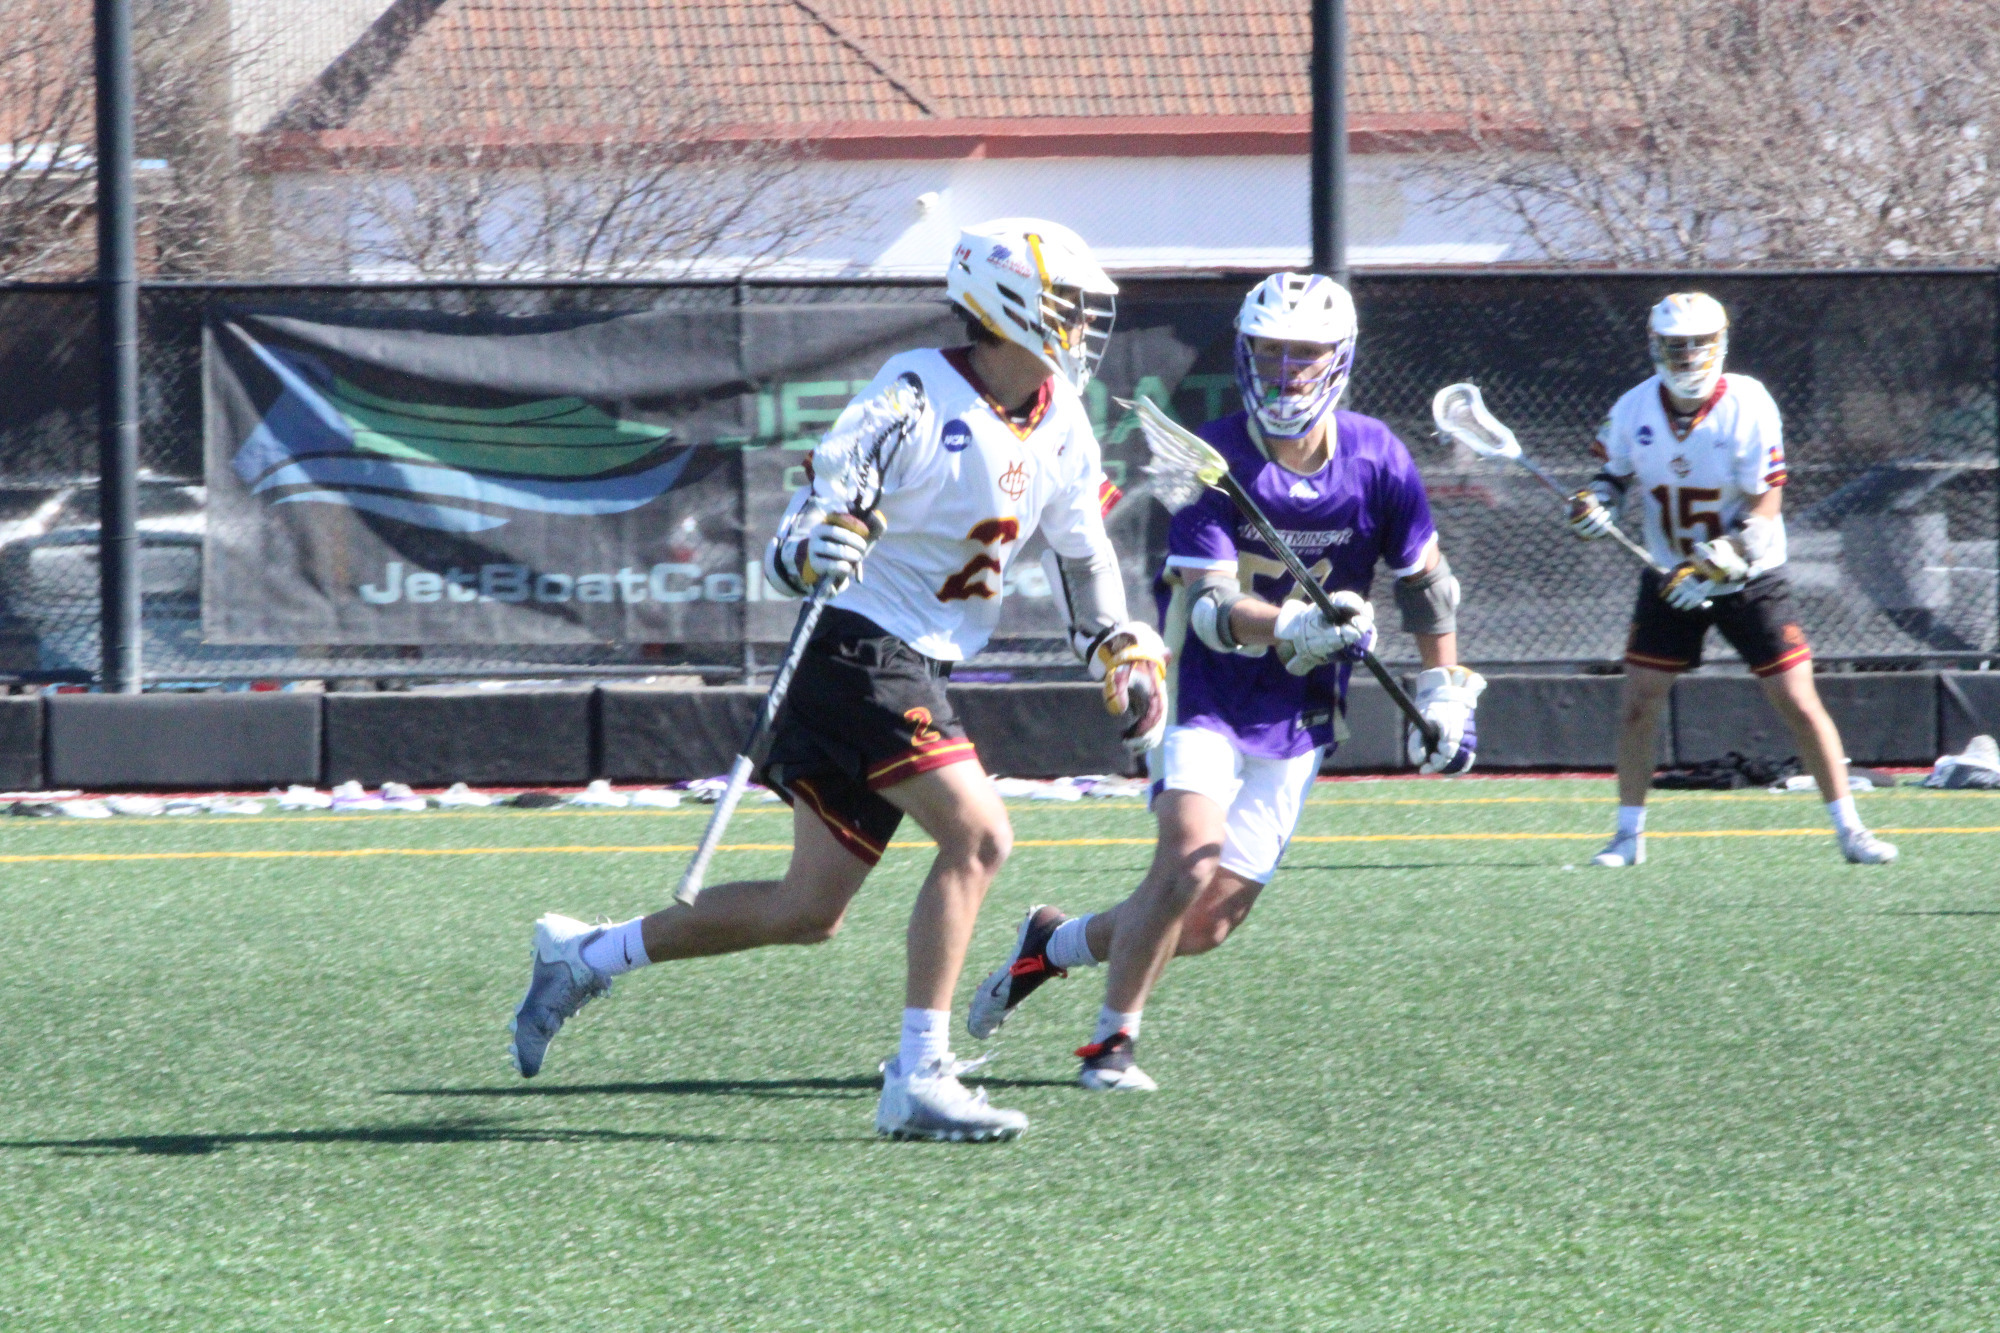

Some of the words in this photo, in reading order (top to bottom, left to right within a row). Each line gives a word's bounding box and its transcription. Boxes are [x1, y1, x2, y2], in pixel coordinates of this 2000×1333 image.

[1651, 484, 1724, 557] 15
[936, 516, 1020, 603] 2
[903, 706, 941, 747] 2
